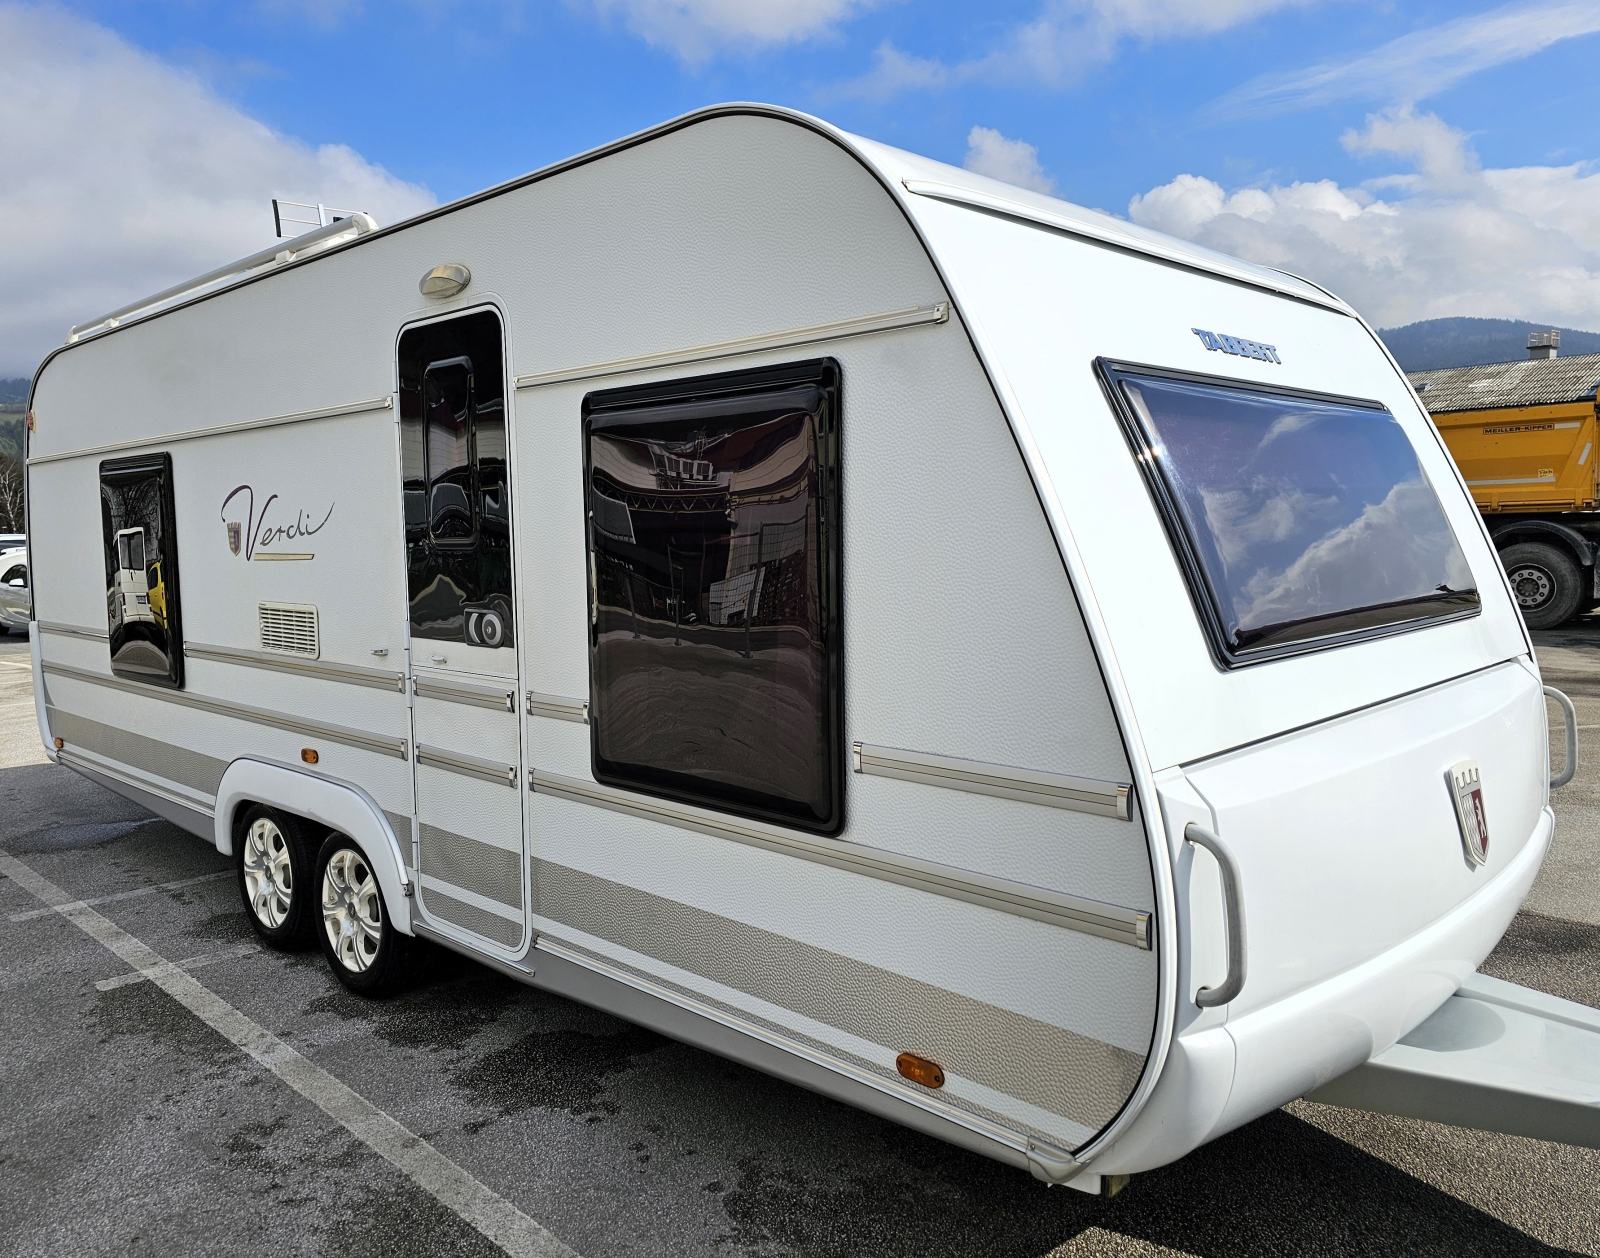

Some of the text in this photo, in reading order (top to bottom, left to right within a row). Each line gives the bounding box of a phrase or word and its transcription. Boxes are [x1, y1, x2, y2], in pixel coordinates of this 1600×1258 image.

[1190, 327, 1282, 365] TABBERT
[1484, 424, 1553, 434] MEILLER-KIPPER
[220, 484, 336, 562] Verdi
